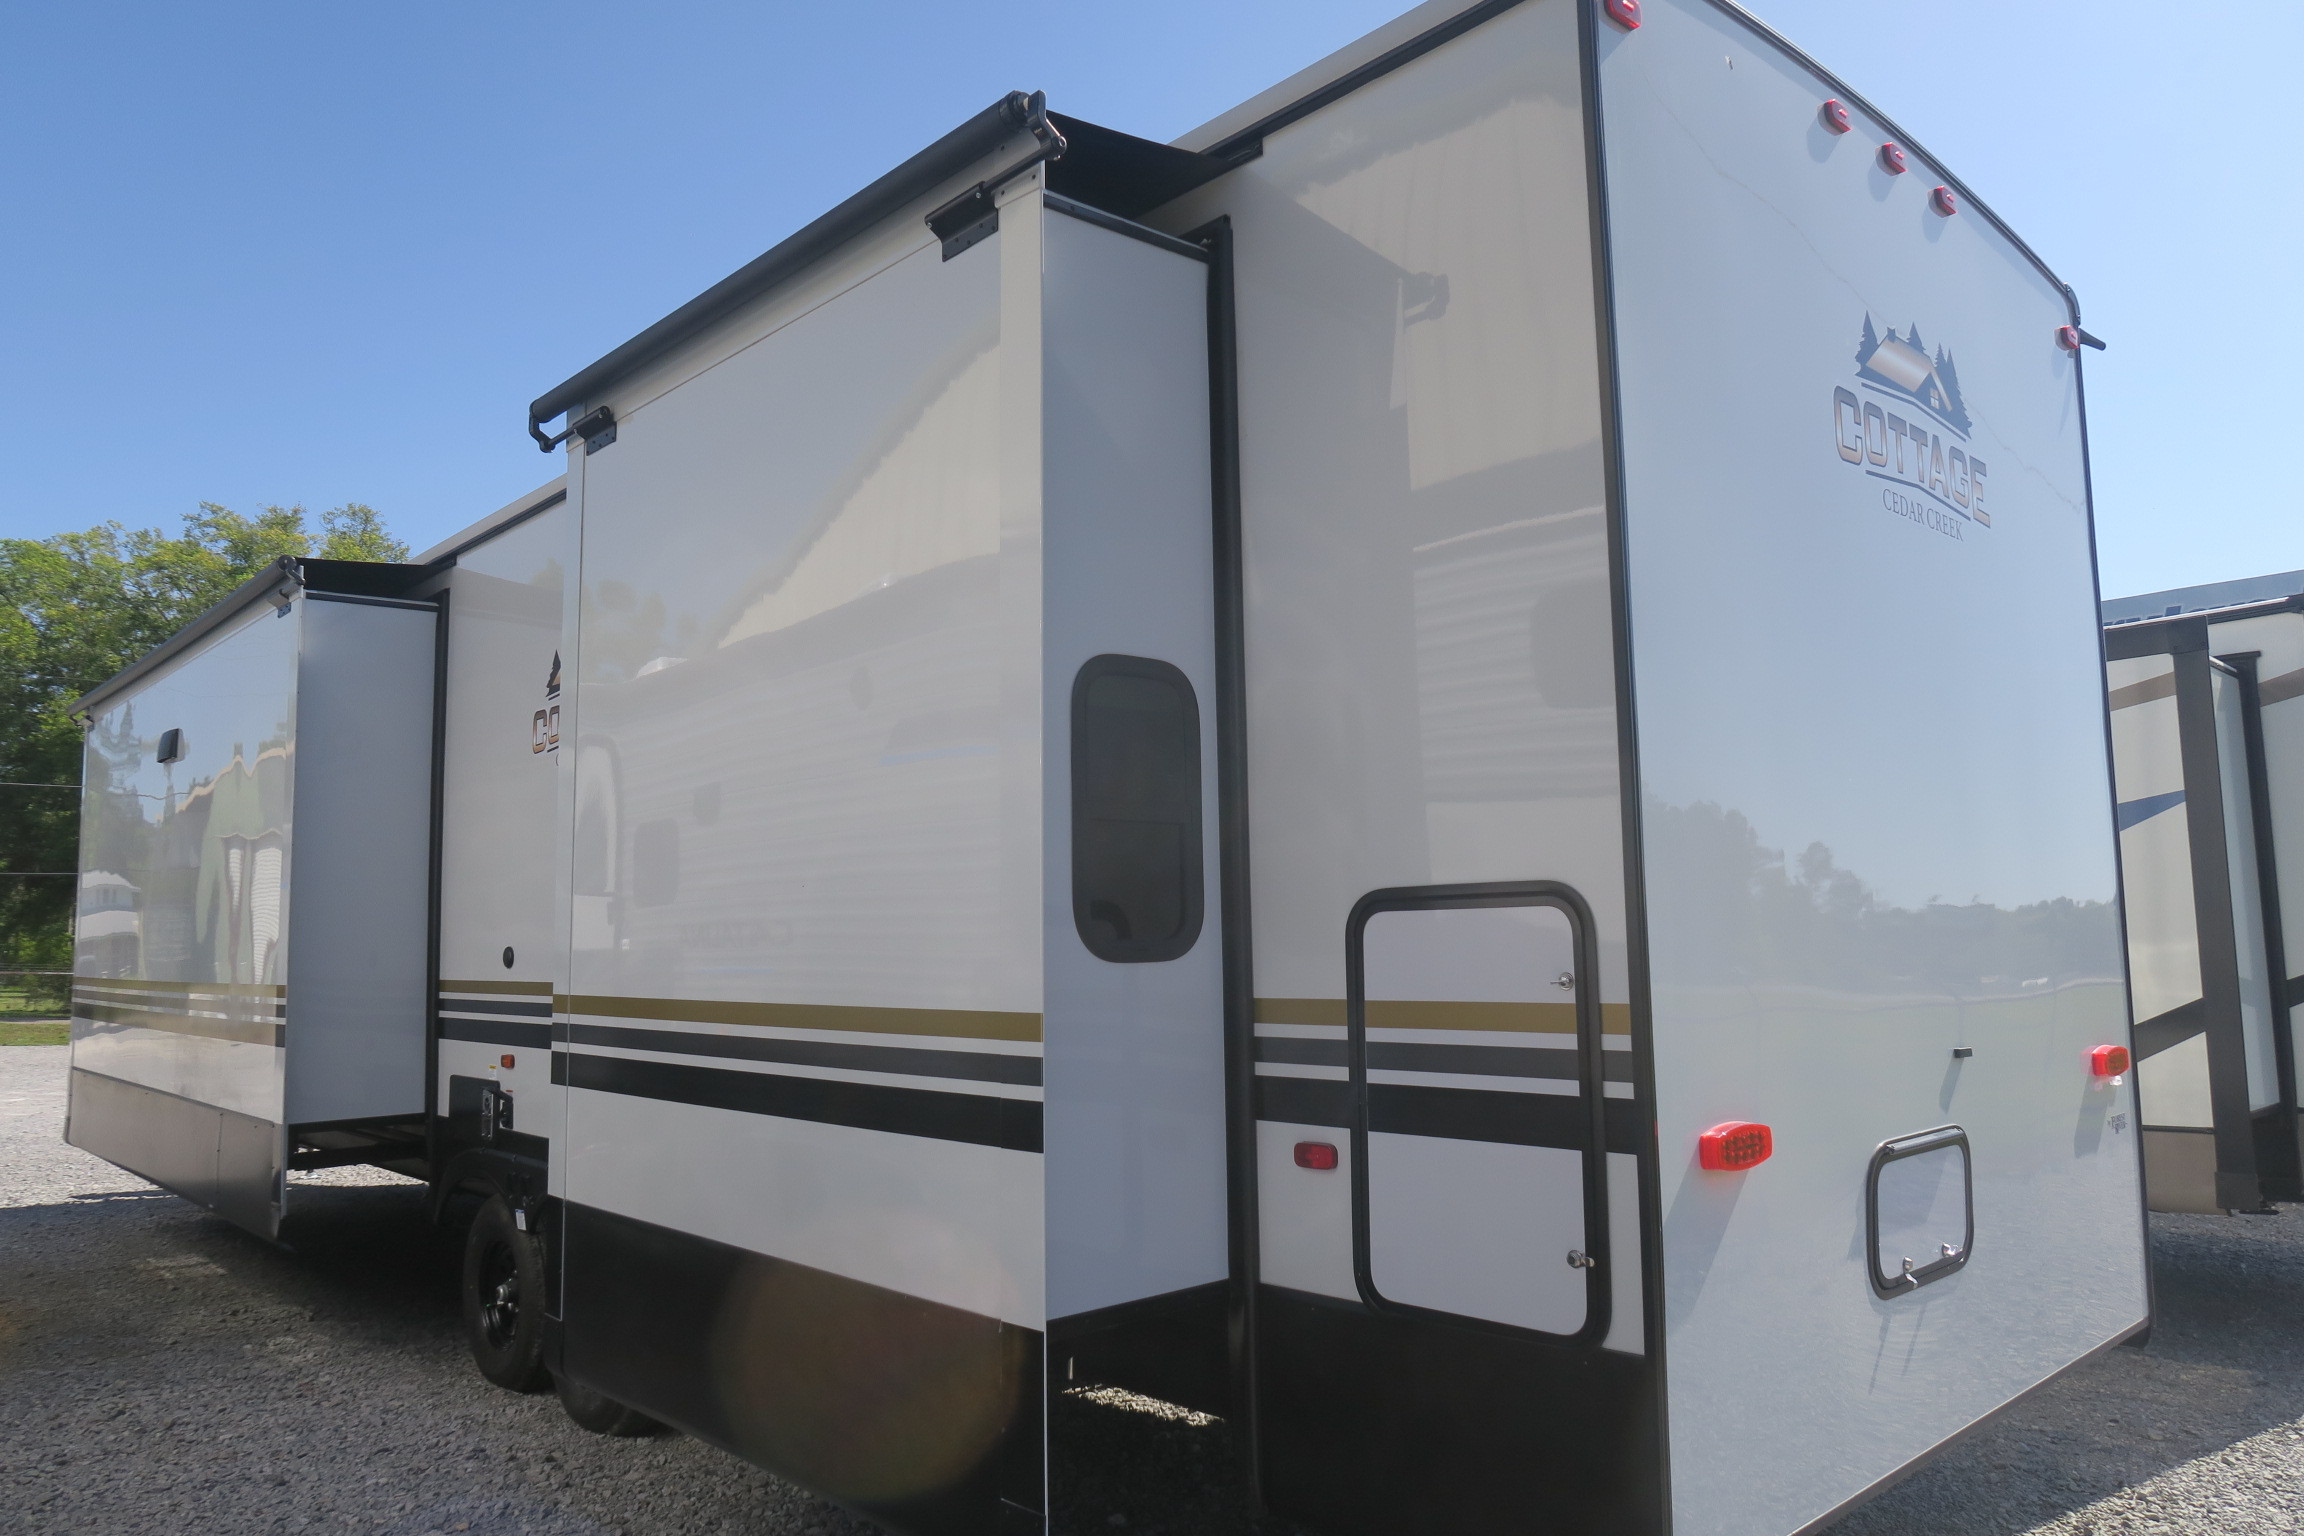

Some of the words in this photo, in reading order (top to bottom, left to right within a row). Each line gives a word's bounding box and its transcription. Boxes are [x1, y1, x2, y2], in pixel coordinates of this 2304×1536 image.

[1833, 384, 1991, 529] COTTAGE
[1882, 487, 1925, 526] CEDAR
[1926, 507, 1964, 542] CREEK
